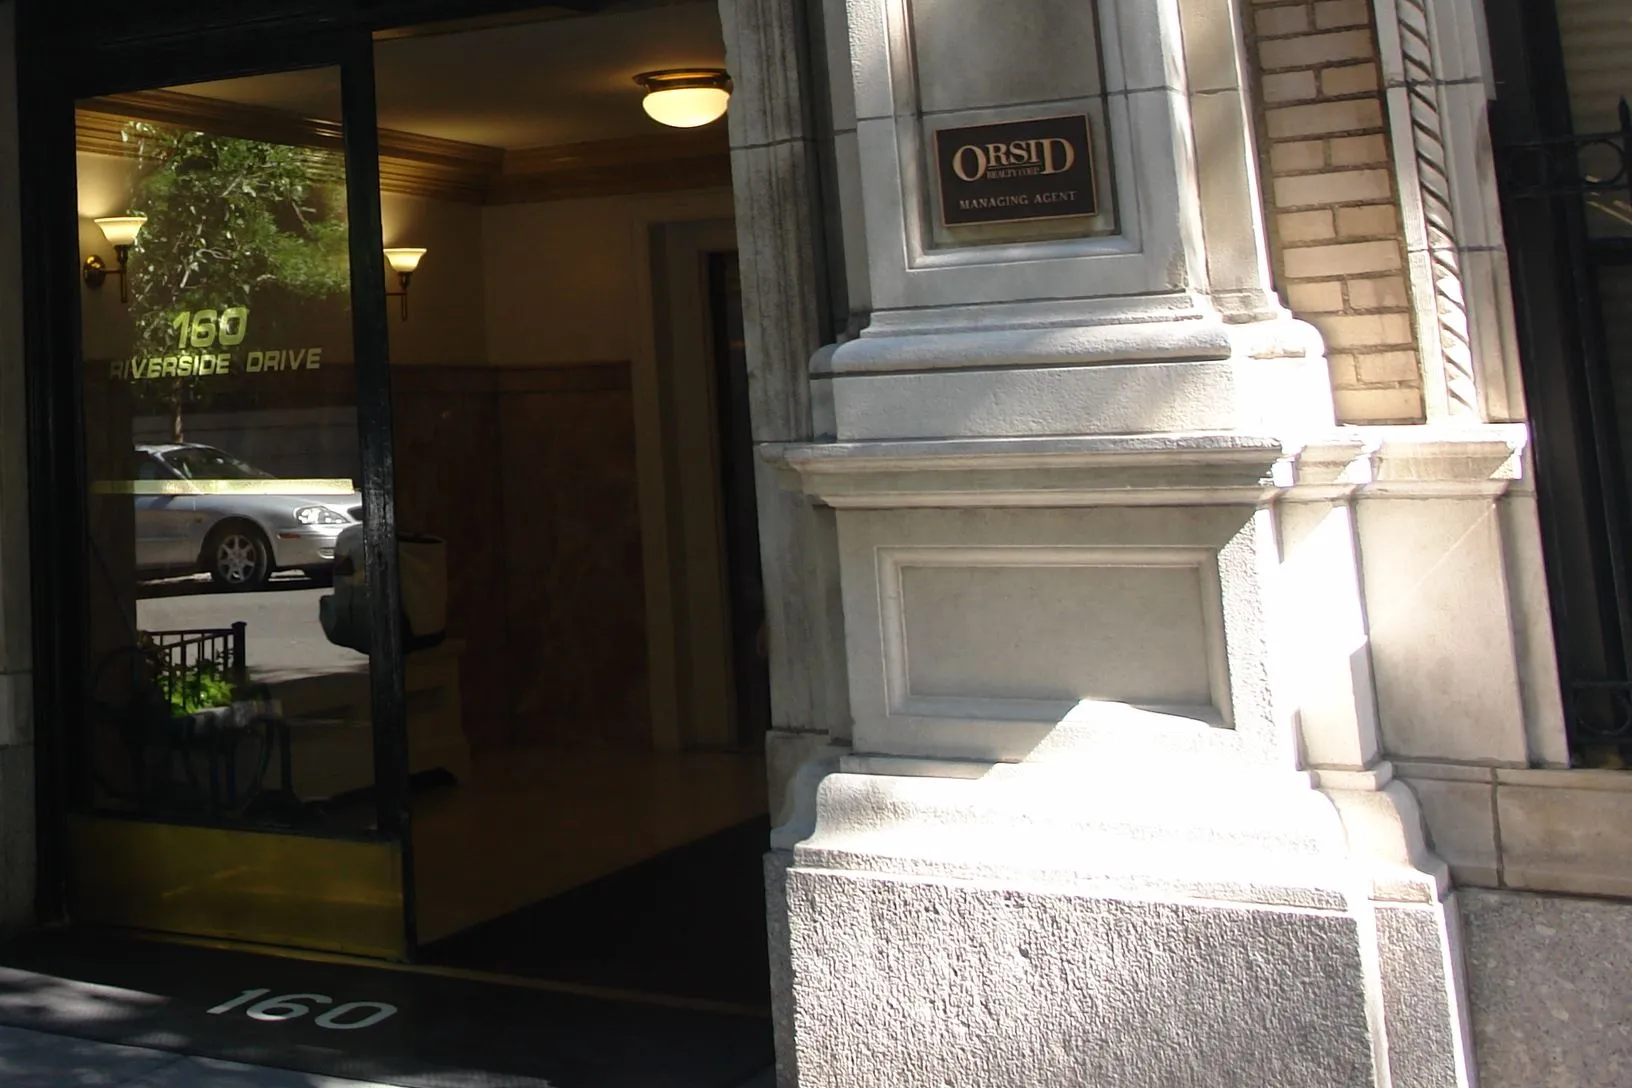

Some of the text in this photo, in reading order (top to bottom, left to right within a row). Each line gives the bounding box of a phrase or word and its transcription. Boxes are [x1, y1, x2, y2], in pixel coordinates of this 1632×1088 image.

[959, 191, 1077, 210] MANAGING AGENT
[172, 306, 249, 349] 160
[110, 347, 322, 381] RIVERSIDE DRIVE
[206, 988, 398, 1030] 160
